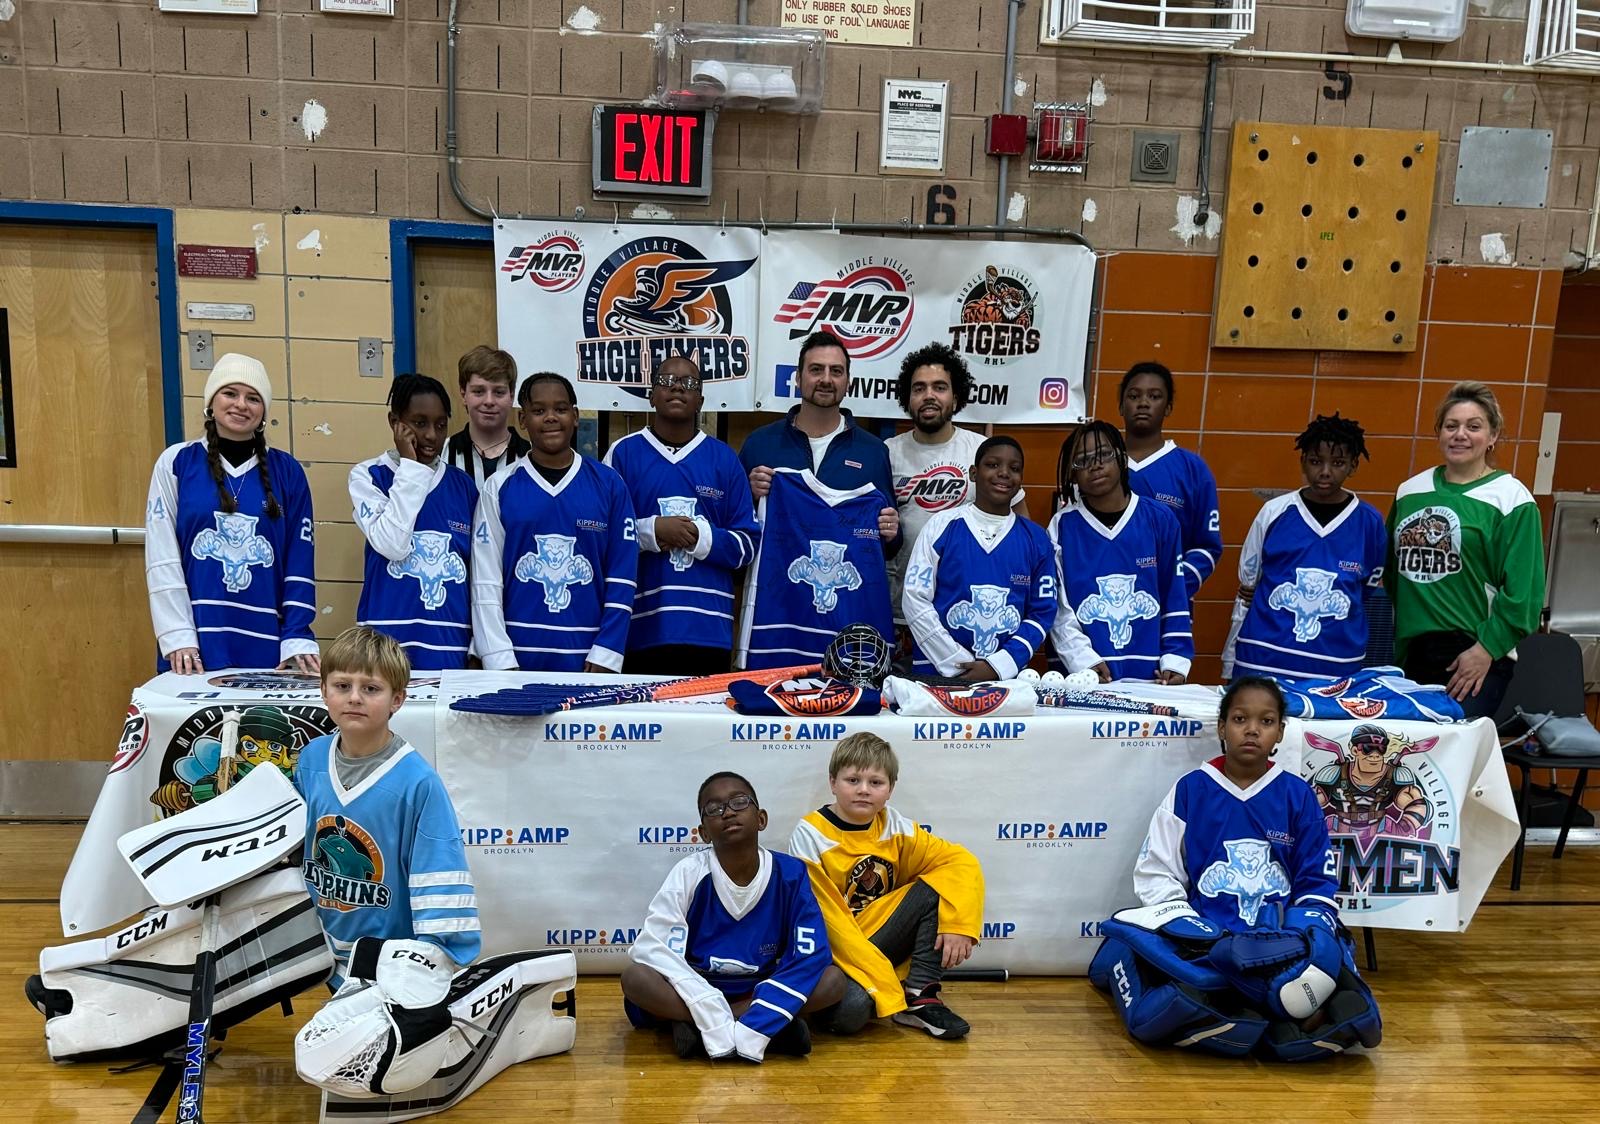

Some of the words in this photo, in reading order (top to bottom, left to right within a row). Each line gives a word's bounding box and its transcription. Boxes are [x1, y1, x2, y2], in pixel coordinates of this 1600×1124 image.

[785, 0, 807, 10] ONLY
[813, 1, 845, 12] RUBBER
[851, 3, 878, 14] SOLED
[883, 6, 911, 16] SHOES
[785, 13, 796, 22] NO
[802, 14, 818, 24] USE
[824, 15, 835, 25] OF
[840, 17, 861, 27] FOUL
[866, 18, 910, 30] LANGUAGE
[1323, 52, 1353, 100] 5
[898, 89, 922, 100] NYC
[615, 113, 698, 183] EXIT
[926, 184, 957, 225] 6
[537, 230, 558, 244] MIDDLE
[564, 230, 585, 248] VILLAGE
[586, 268, 610, 323] MIDDLE
[619, 240, 678, 261] VILLAGE
[836, 256, 873, 280] MIDDLE
[883, 257, 915, 287] VILLAGE
[957, 274, 982, 303] MIDDLE
[1001, 267, 1033, 288] VILLAGE
[855, 325, 897, 335] PLAYERS
[948, 323, 1041, 356] TIGERS
[578, 339, 643, 383] HIGH
[984, 357, 1006, 365] RHL
[300, 518, 314, 544] 2
[623, 517, 638, 543] 2
[1208, 510, 1220, 531] 2
[907, 565, 933, 588] 24
[545, 723, 662, 741] KIPP:AMP
[732, 723, 846, 740] KIPP:AMP
[914, 722, 1025, 739] KIPP:AMP
[1092, 720, 1203, 738] KIPP:AMP
[1418, 761, 1449, 829] VILLAGE
[201, 824, 288, 862] CCM
[639, 827, 698, 843] KIPP:
[998, 822, 1108, 839] KIPP:AMP
[1323, 849, 1336, 876] 2
[1331, 837, 1461, 895] MEN
[303, 861, 389, 905] PHINS
[116, 913, 169, 949] CCM
[546, 929, 642, 945] KIPP:AM
[668, 926, 686, 954] 2
[391, 950, 437, 970] CCM
[1113, 959, 1134, 1008] CCM
[470, 977, 514, 1018] CCM
[180, 1022, 207, 1120] MYLEC
